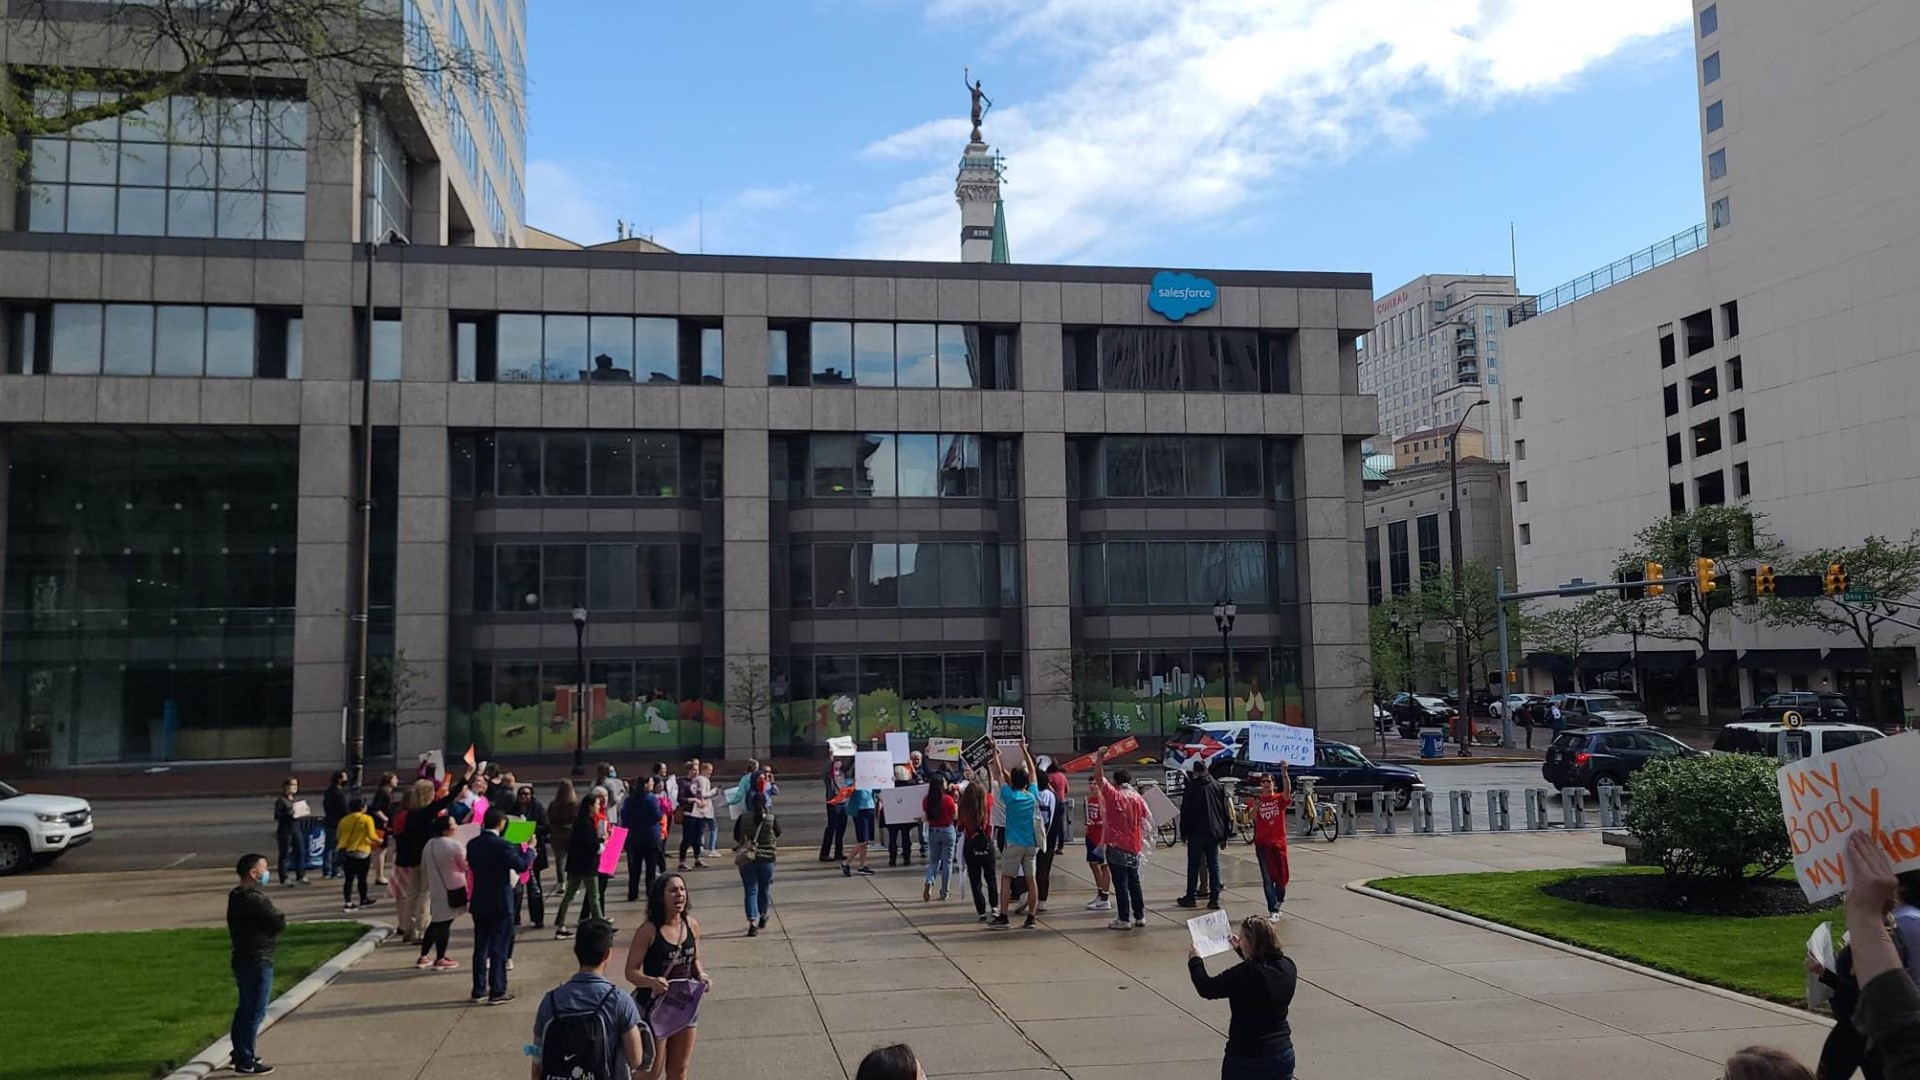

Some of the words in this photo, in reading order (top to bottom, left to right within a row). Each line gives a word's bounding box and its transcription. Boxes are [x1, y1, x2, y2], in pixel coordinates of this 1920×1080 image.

[1158, 287, 1211, 300] salesforce
[1376, 292, 1409, 314] CONRAD
[1790, 714, 1799, 726] B
[1786, 762, 1844, 812] MY
[1788, 788, 1879, 855] BODY
[1804, 853, 1847, 890] MY
